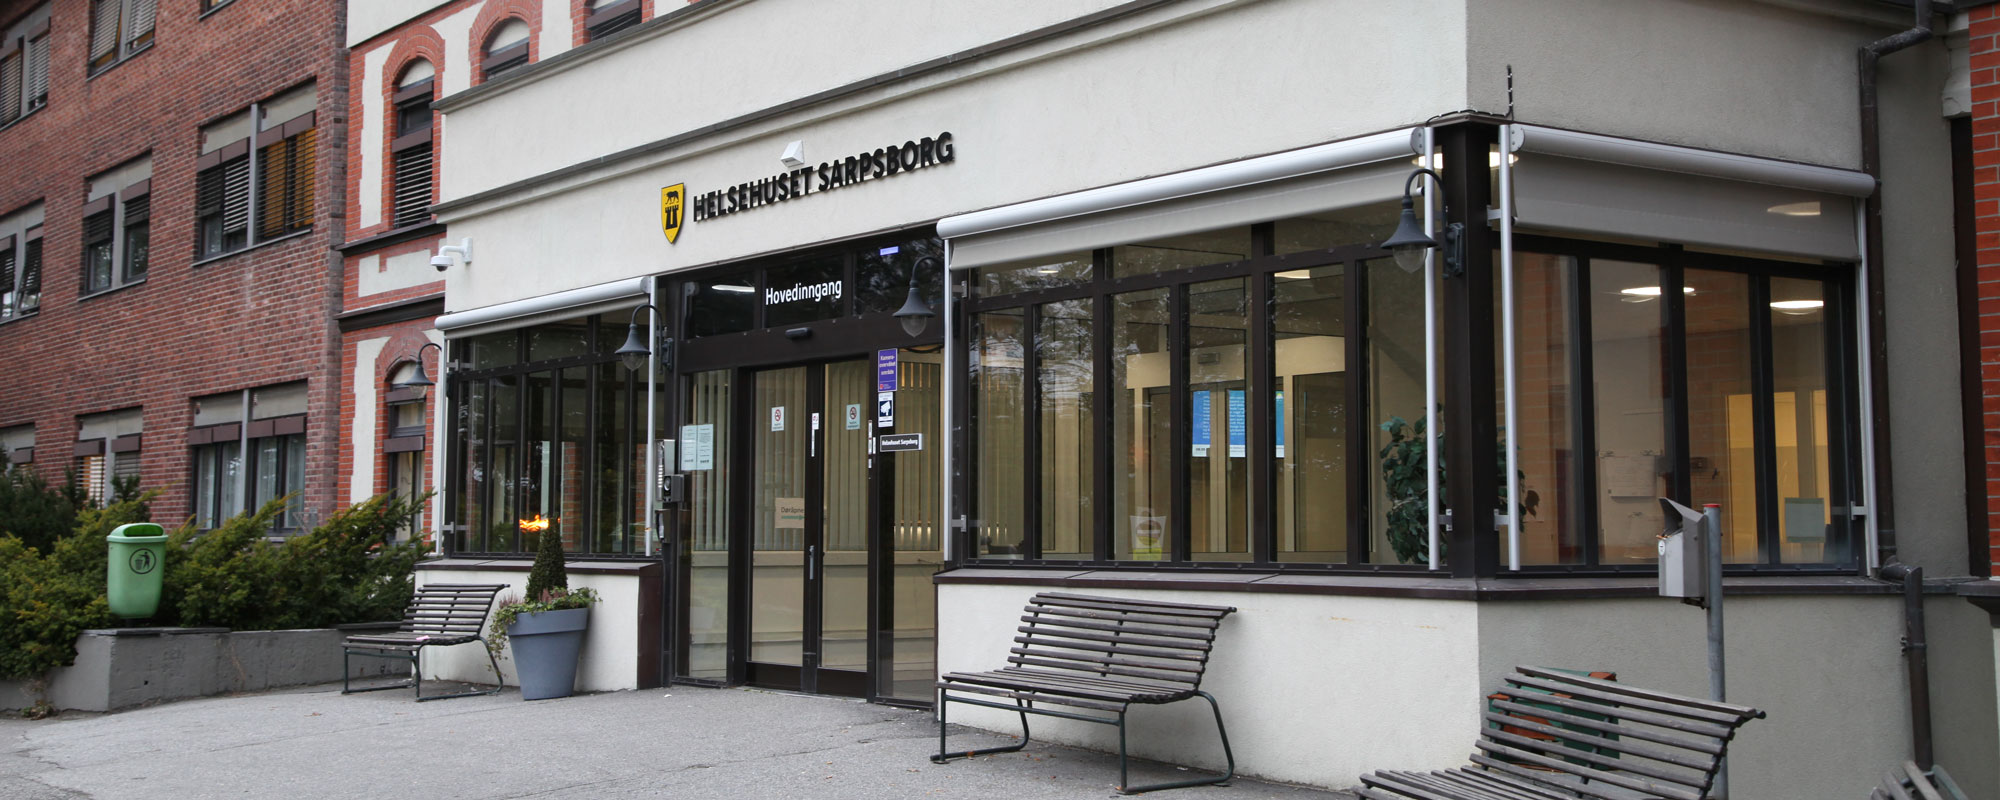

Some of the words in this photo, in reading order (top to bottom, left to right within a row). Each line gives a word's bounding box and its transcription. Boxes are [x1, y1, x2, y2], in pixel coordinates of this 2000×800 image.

[693, 166, 813, 222] HELSEHUSET
[818, 131, 955, 192] SARPSBORG
[765, 280, 842, 305] Hovedinngang
